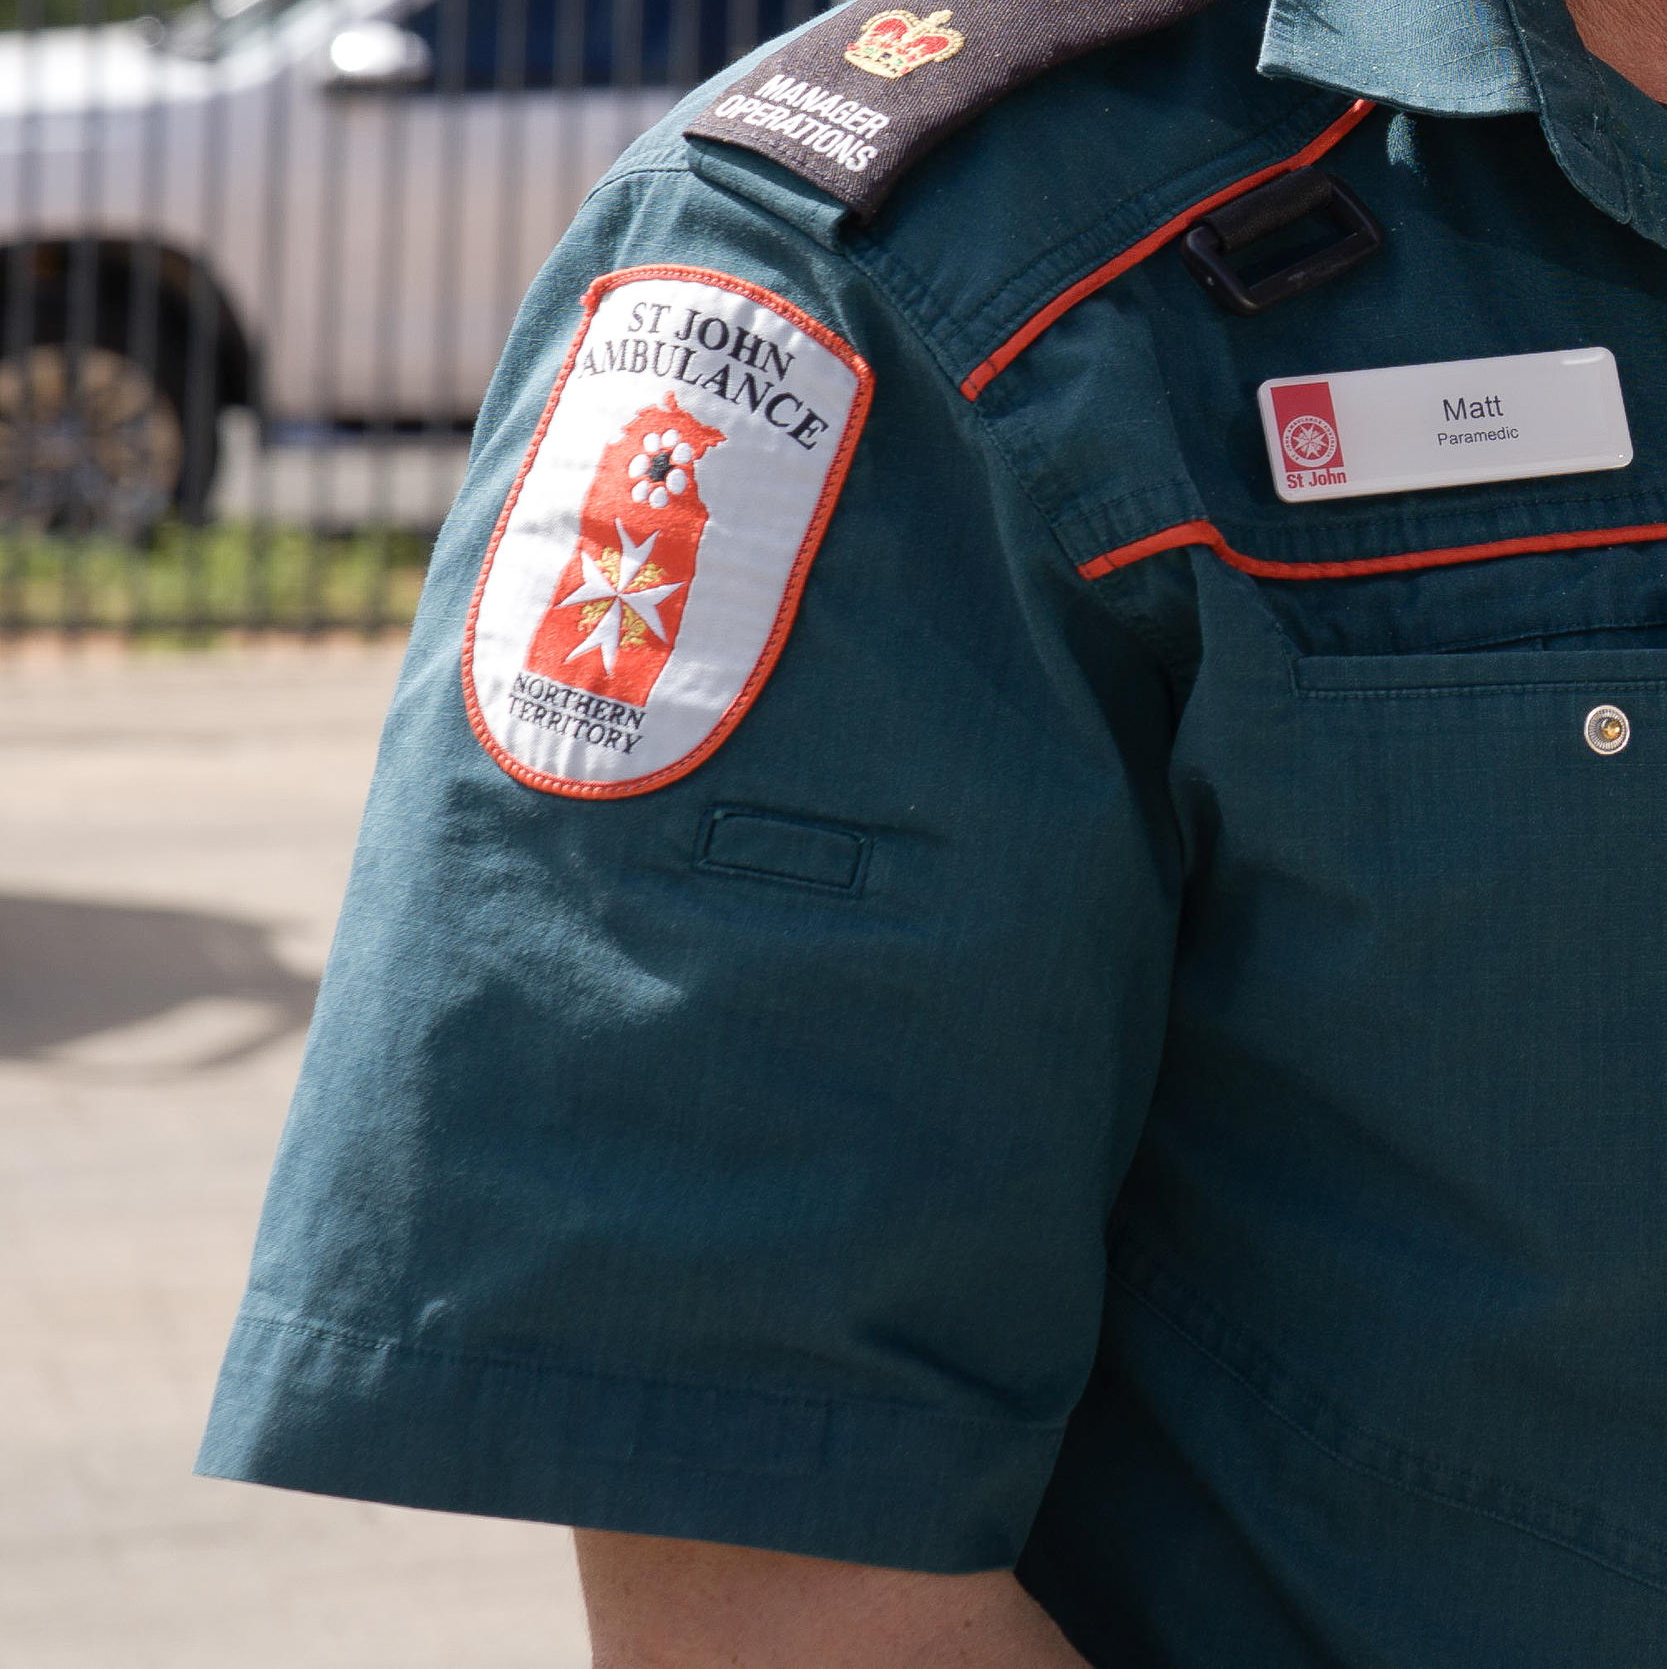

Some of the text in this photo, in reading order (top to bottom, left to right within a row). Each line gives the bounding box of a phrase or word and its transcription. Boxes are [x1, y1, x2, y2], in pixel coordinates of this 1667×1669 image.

[715, 93, 878, 173] OPERATIONS
[758, 75, 890, 139] MANAGER
[627, 301, 795, 380] ST JOHN
[577, 340, 830, 450] AMBULANCE
[1443, 395, 1504, 421] Matt
[1438, 426, 1519, 446] Paramedic
[1286, 471, 1348, 490] St John
[509, 695, 643, 754] TERRITORY
[514, 671, 646, 730] NORTHERN
